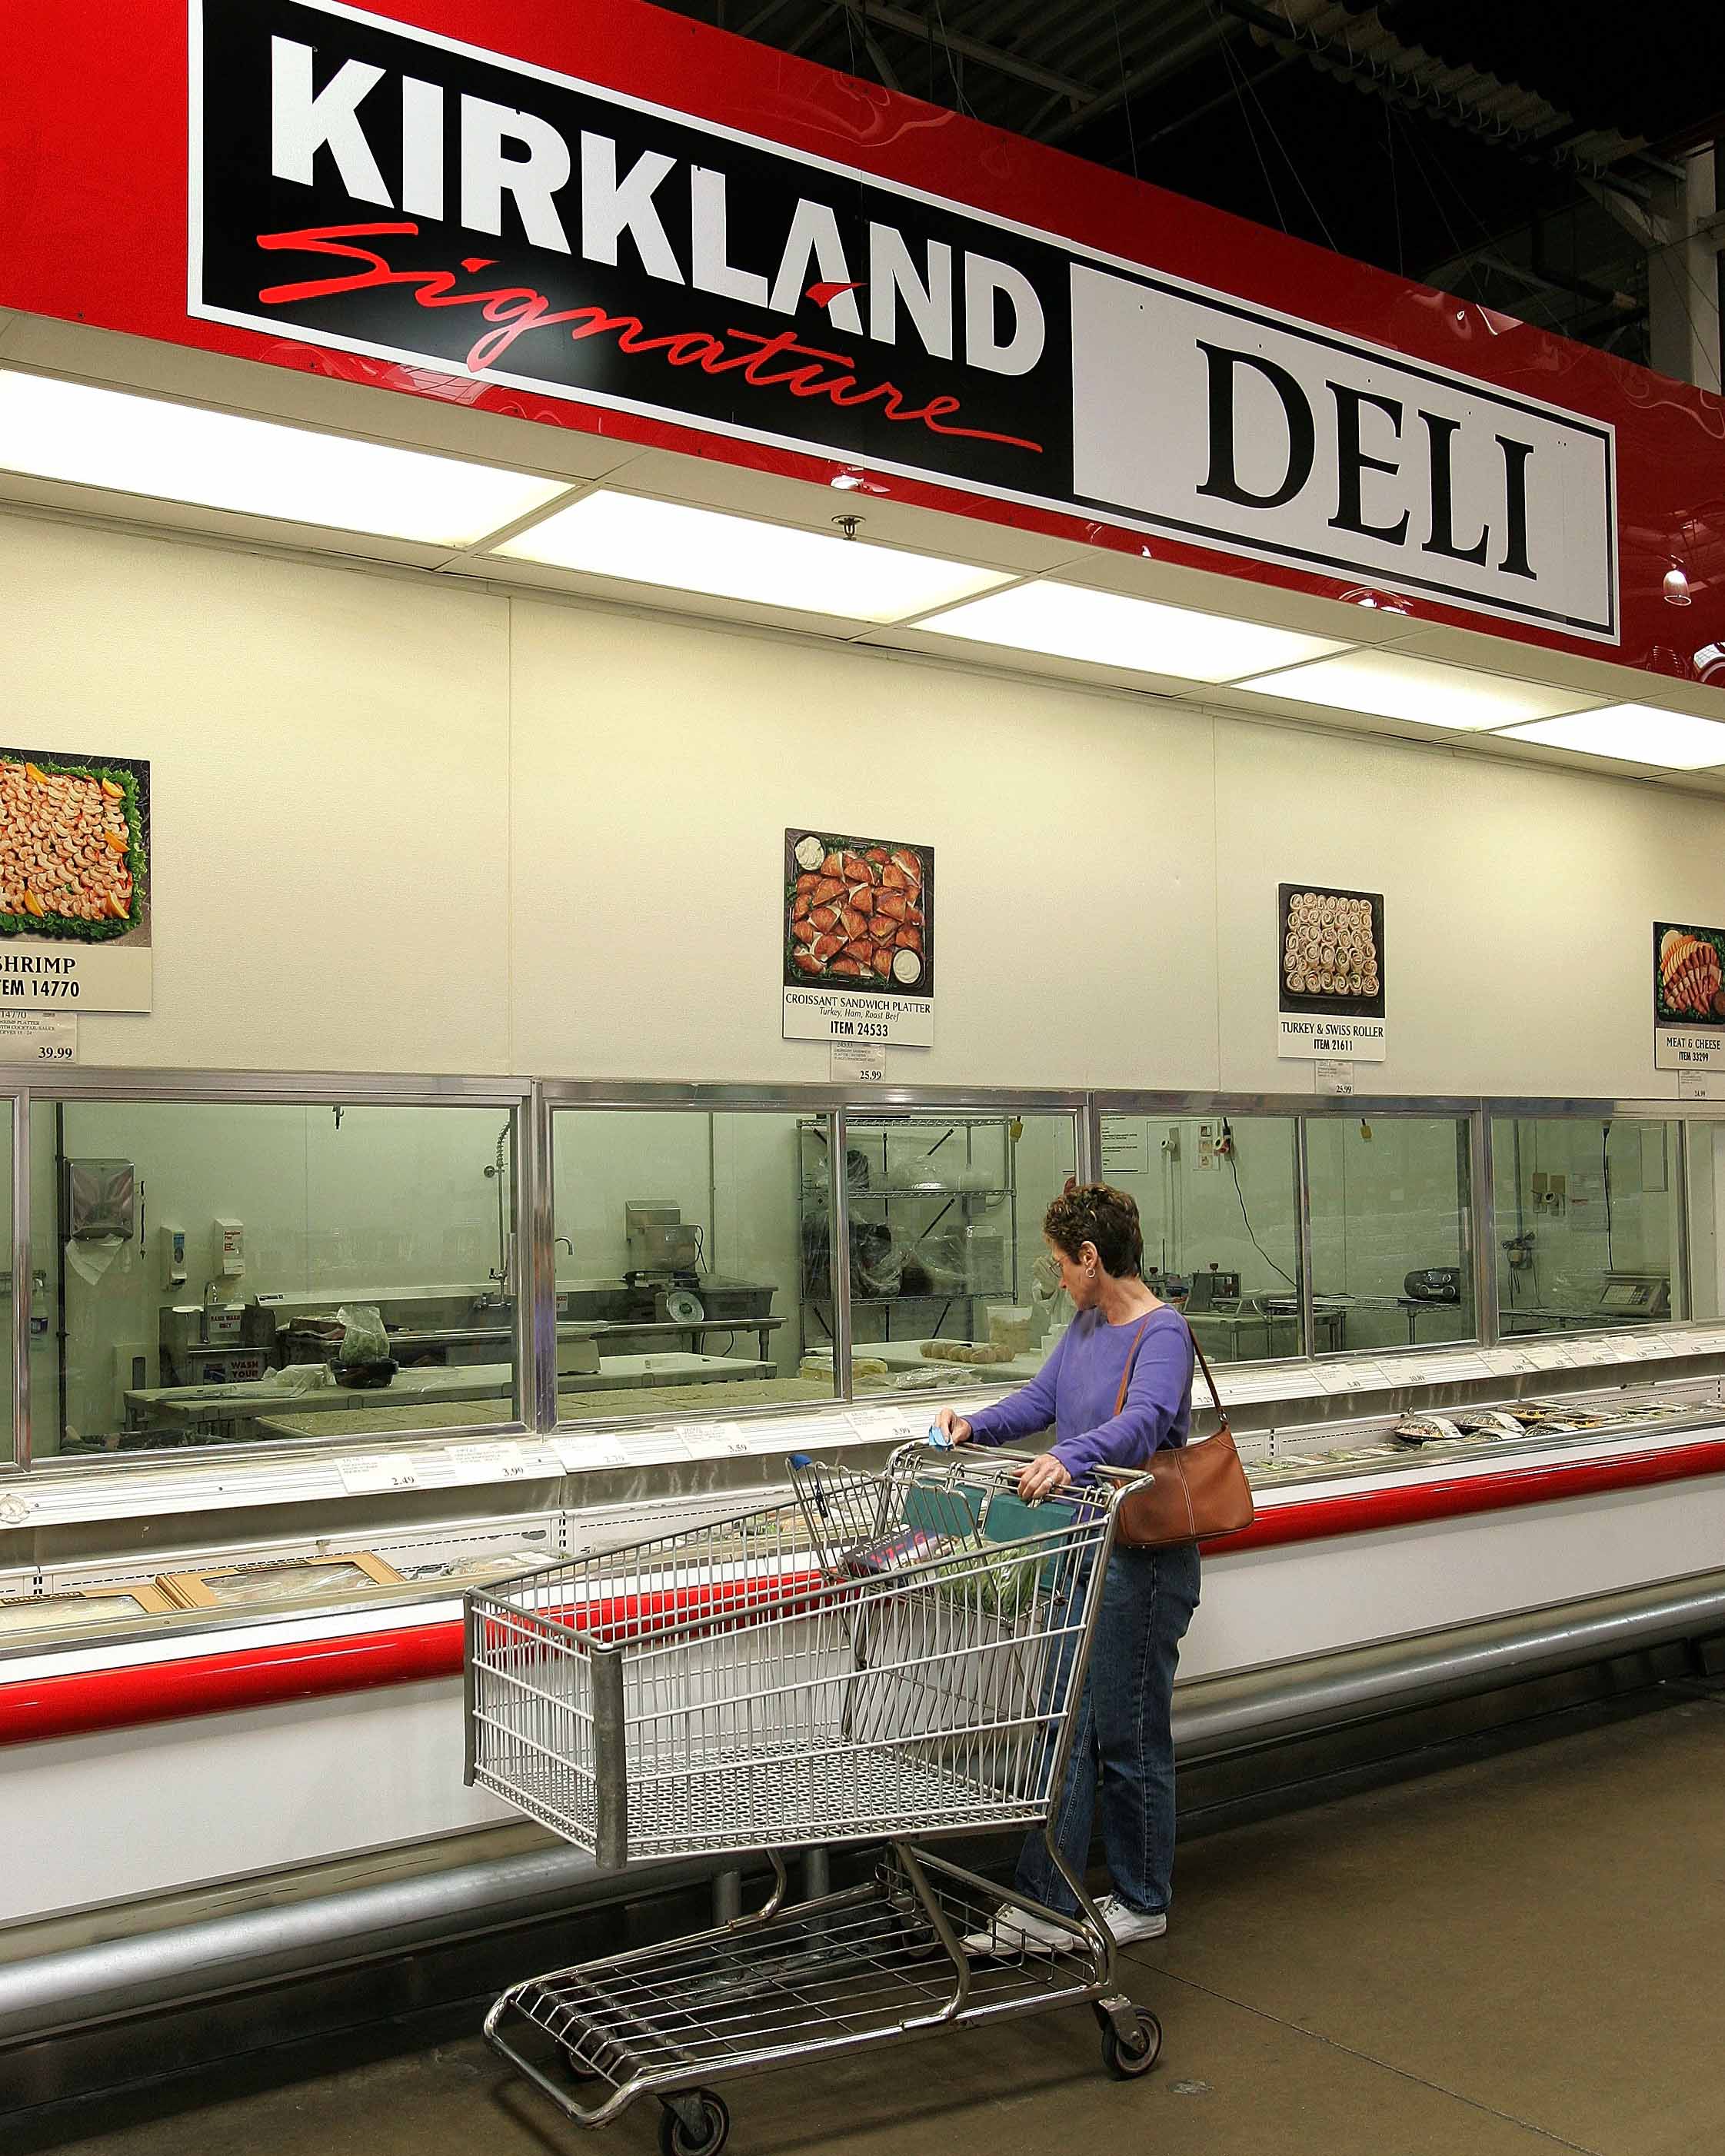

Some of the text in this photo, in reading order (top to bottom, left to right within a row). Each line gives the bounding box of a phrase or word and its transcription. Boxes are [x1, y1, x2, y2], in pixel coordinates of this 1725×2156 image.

[271, 34, 1046, 377] KIRKLAND
[256, 220, 1044, 454] Signature
[1194, 338, 1537, 582] DELI
[32, 980, 80, 997] 14770
[786, 993, 931, 1013] CROISSANT SANDWICH PLATTER
[820, 1007, 901, 1022] Turkey, Ham, Roast Beef
[831, 1021, 888, 1036] ITEM 24533
[1281, 1021, 1384, 1037] TURKEY & SWISS ROLLER
[1314, 1039, 1353, 1051] ITEM 21611
[1667, 1036, 1720, 1050] MEAT & CHEESE
[38, 1046, 72, 1059] 39.99
[1679, 1051, 1691, 1061] ITEM
[860, 1070, 881, 1080] 25.99
[231, 1360, 258, 1369] WASH
[232, 1369, 258, 1378] YOUR
[728, 1444, 748, 1452] 3.59
[503, 1467, 524, 1477] 3.99
[392, 1476, 415, 1486] 2.49
[3, 1592, 81, 1602] KIRKLAND
